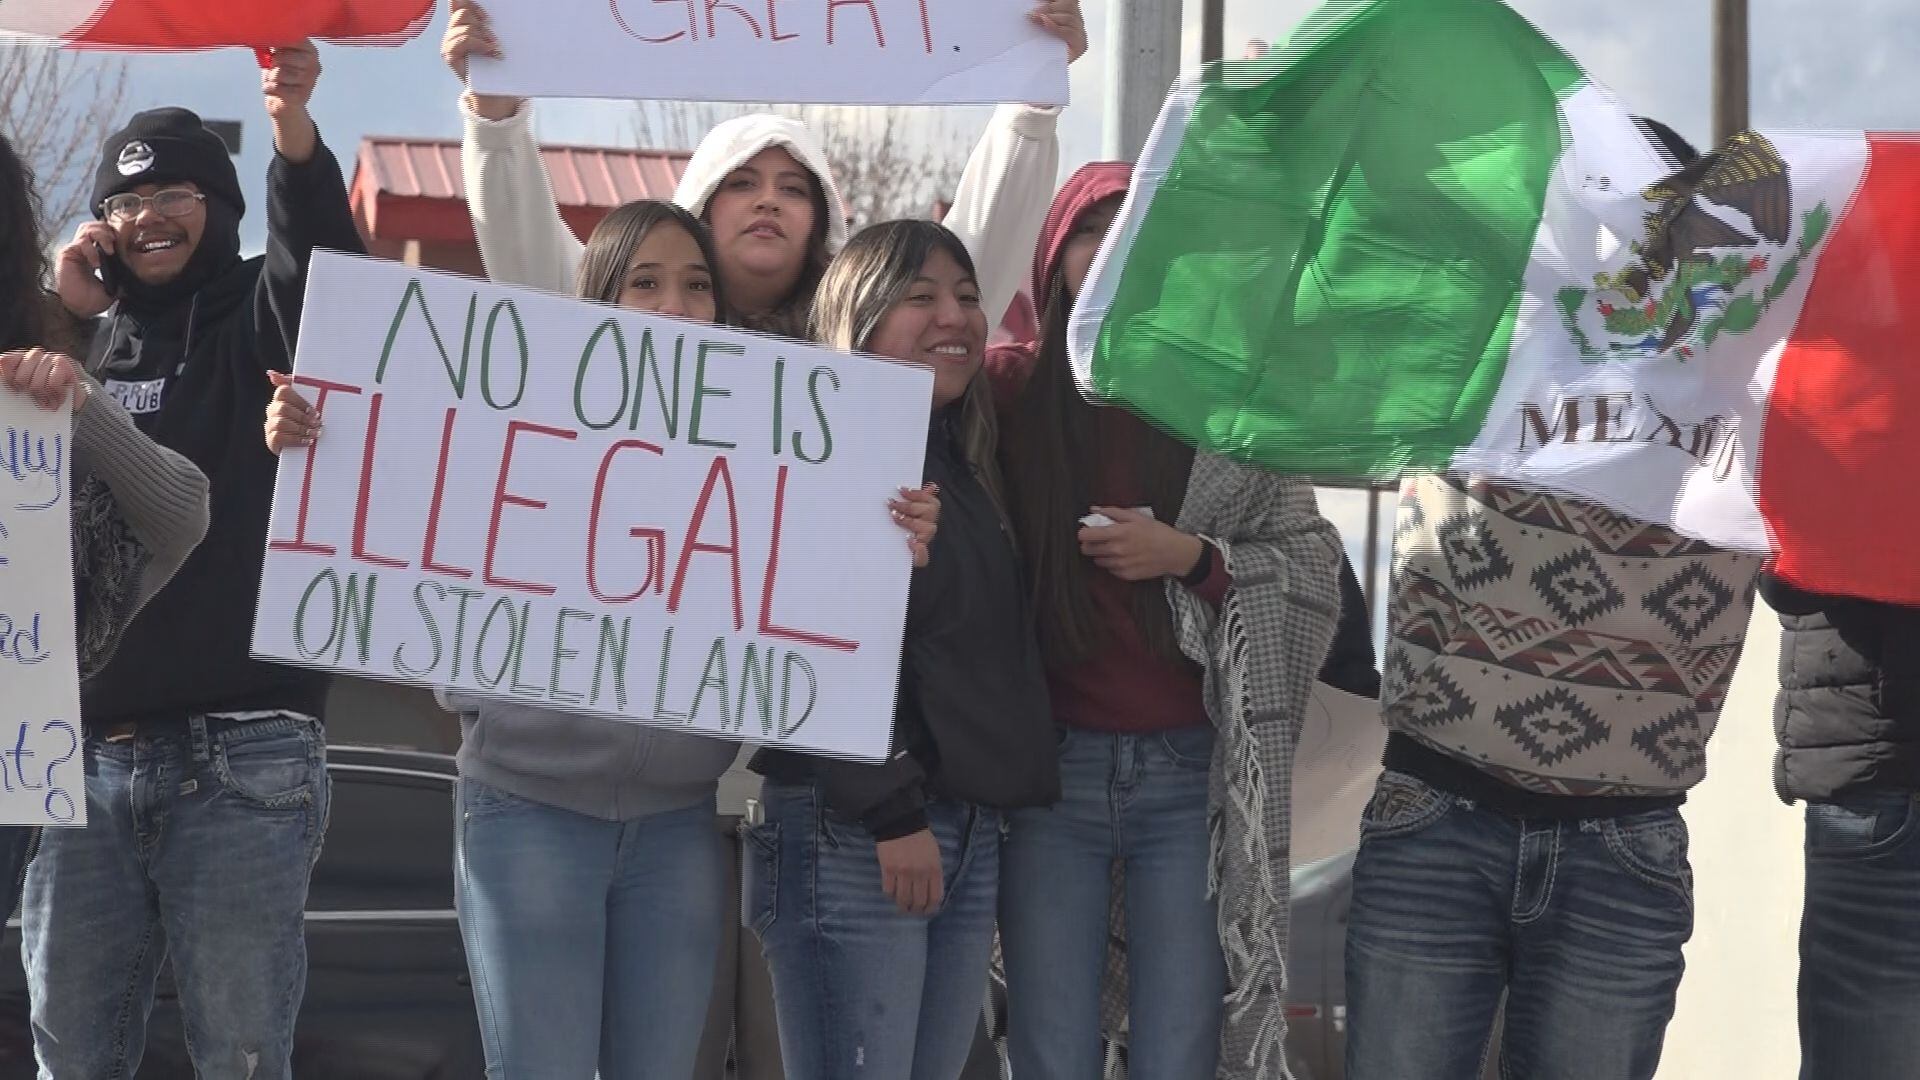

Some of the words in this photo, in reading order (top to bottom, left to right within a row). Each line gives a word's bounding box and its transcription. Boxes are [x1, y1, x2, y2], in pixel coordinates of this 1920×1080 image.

[109, 392, 160, 410] LUB
[376, 278, 529, 410] NO
[574, 318, 745, 450] ONE
[772, 356, 841, 465] IS
[269, 374, 860, 653] ILLEGAL
[293, 567, 377, 664] ON
[393, 579, 633, 712] STOLEN
[653, 625, 818, 740] LAND
